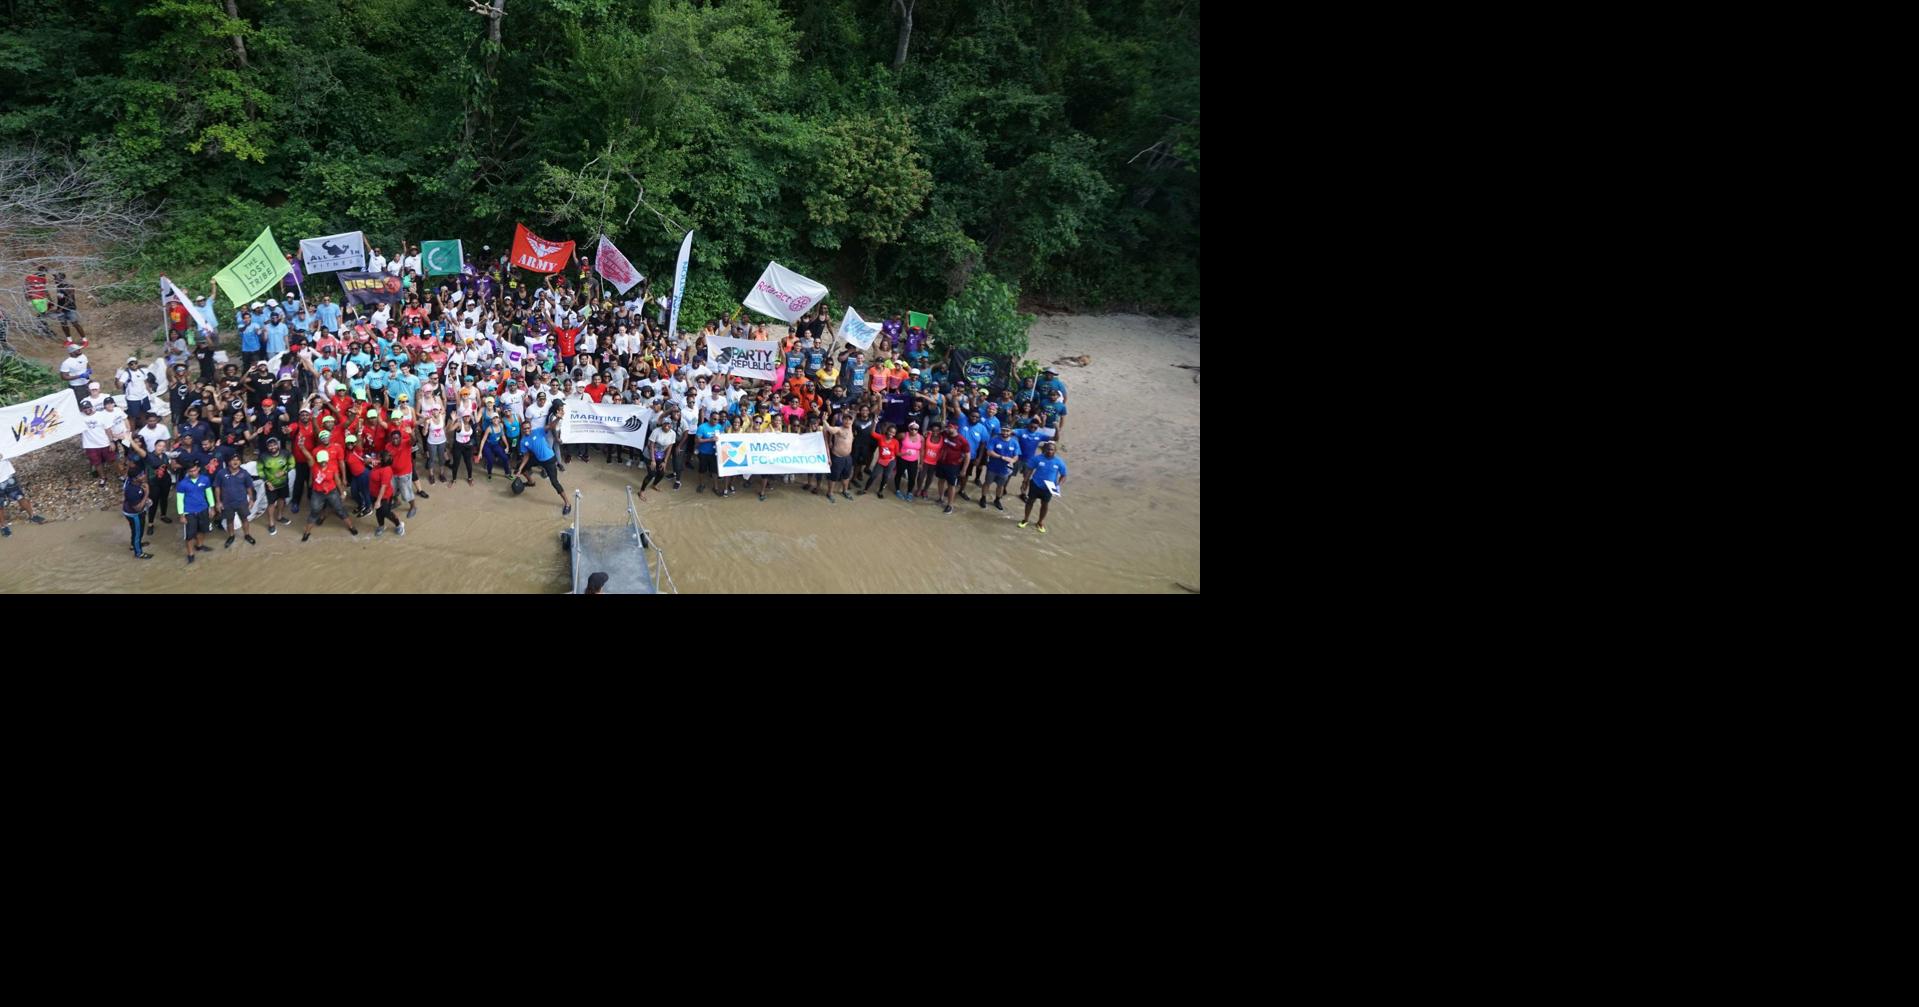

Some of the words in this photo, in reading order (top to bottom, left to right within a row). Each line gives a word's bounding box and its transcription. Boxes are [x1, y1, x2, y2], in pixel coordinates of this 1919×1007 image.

[243, 257, 258, 269] THE
[244, 260, 266, 280] LOST
[517, 254, 558, 272] ARMY
[249, 267, 273, 288] TRIBE
[756, 281, 792, 303] Rotaract
[731, 346, 773, 362] PARTY
[731, 359, 773, 371] REPUBLIC
[570, 413, 623, 423] MARITIME
[749, 442, 790, 452] MASSY
[751, 454, 827, 465] FOUNDATION
